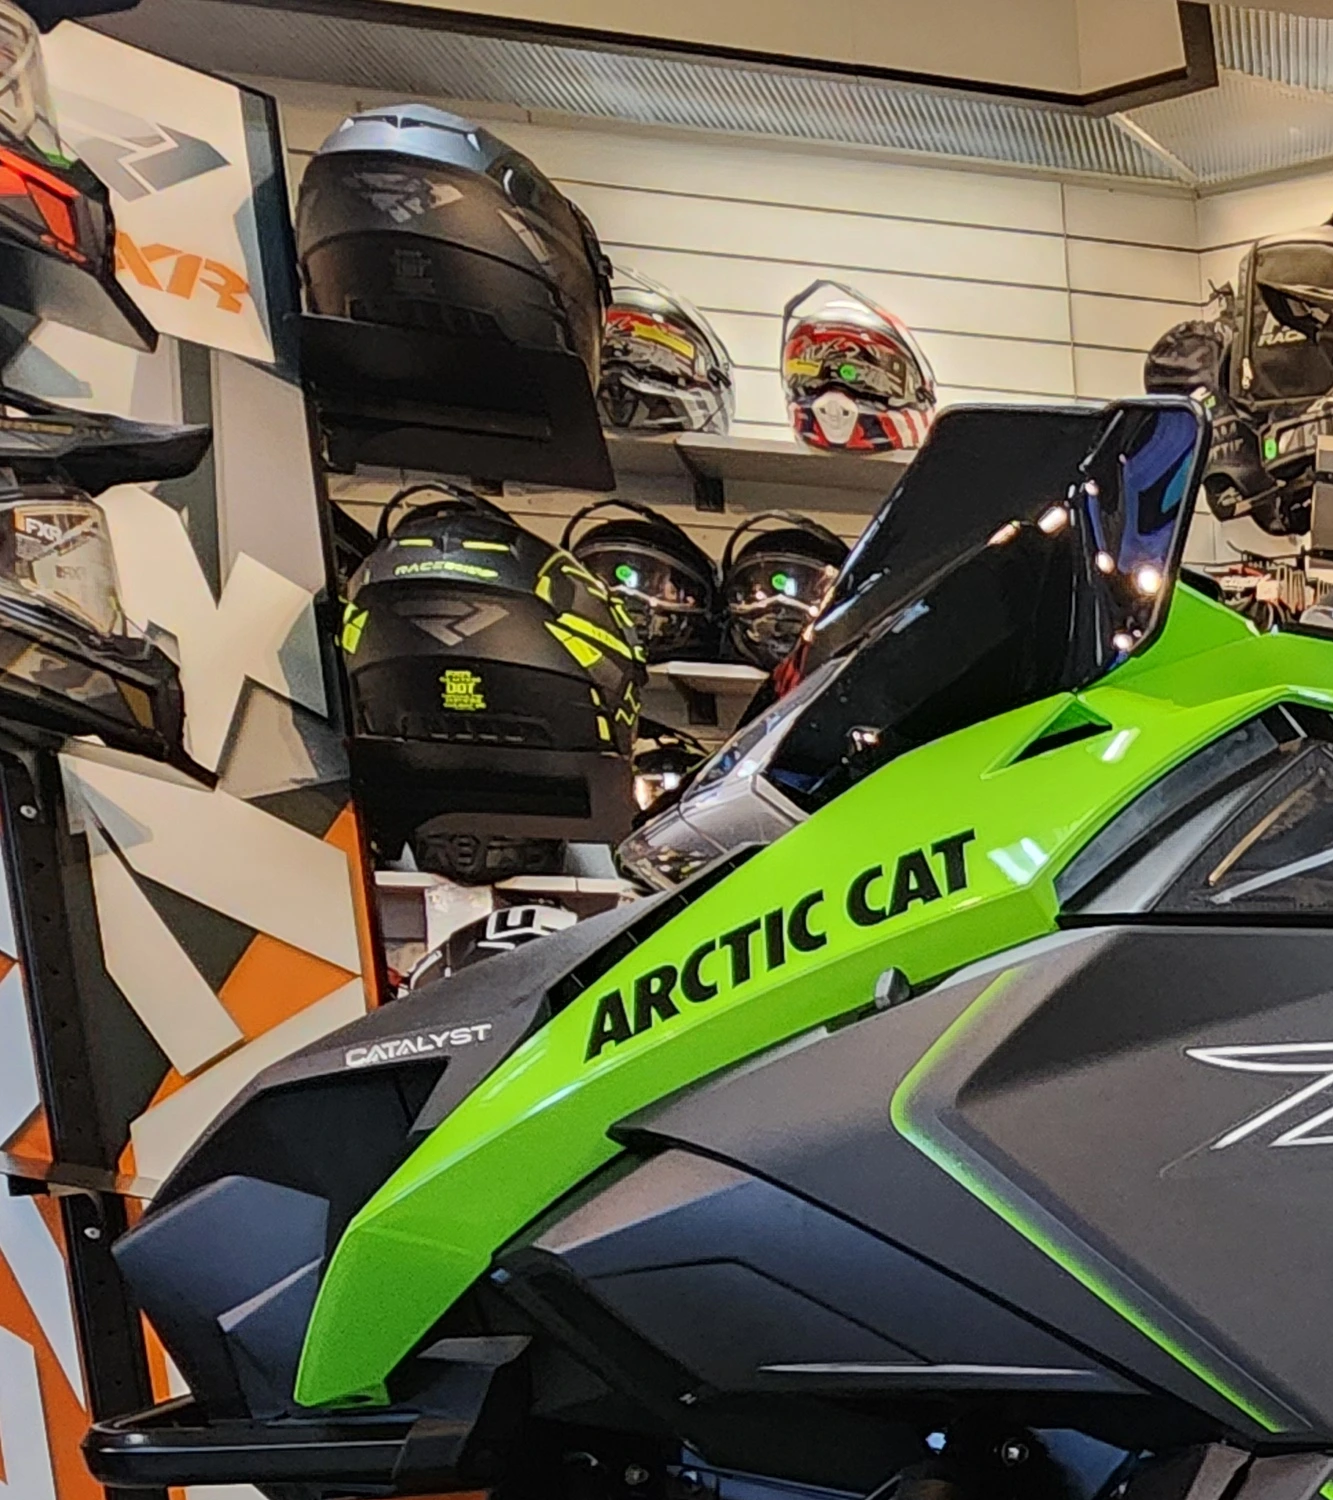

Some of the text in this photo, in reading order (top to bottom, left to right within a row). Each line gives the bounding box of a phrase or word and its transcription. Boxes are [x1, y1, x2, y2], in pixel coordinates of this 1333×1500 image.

[583, 828, 975, 1063] ARCTIC CAT
[345, 1024, 492, 1067] CATALYST
